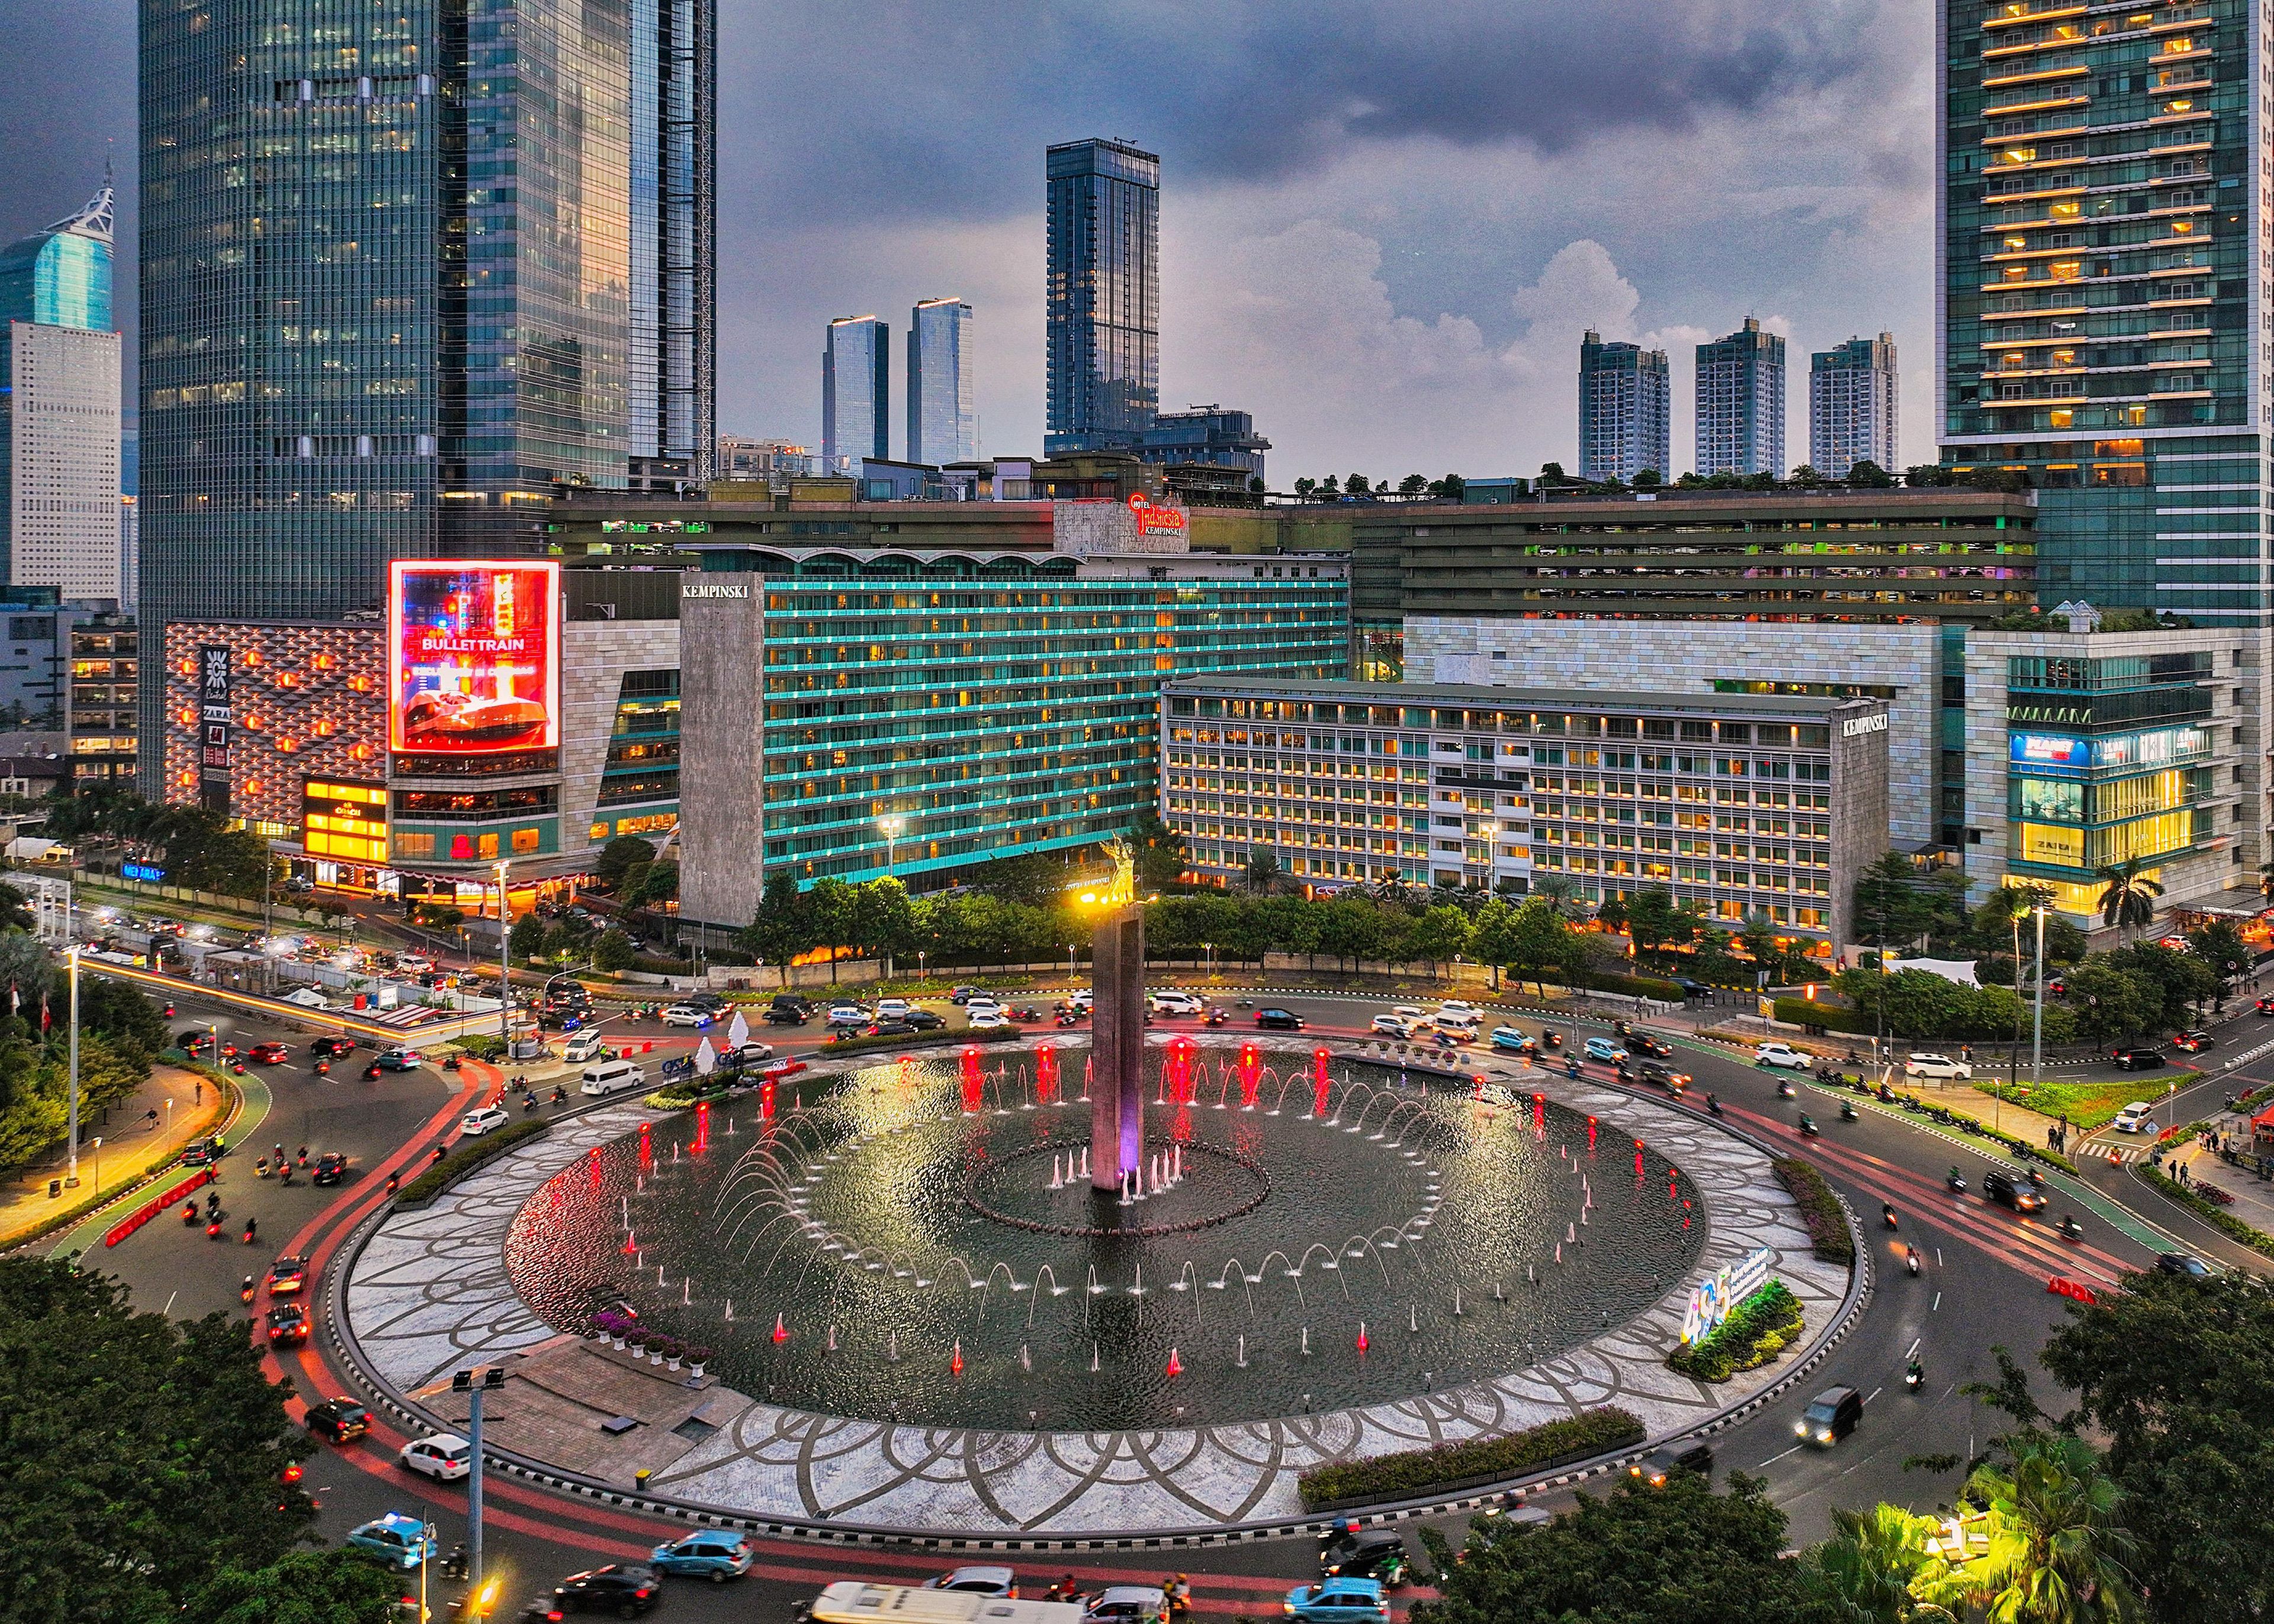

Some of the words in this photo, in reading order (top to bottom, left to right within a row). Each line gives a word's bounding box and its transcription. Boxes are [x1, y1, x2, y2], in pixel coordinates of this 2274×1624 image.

[1145, 526, 1181, 536] KEMPINSKI
[682, 585, 749, 599] KEMPINSKI
[422, 638, 476, 651] BULLET
[477, 638, 525, 651] TRAIN
[204, 709, 229, 719] ZARA
[1843, 713, 1888, 737] KEMPINSKI
[2038, 841, 2070, 851] ZARA
[1681, 1264, 1732, 1345] 495
